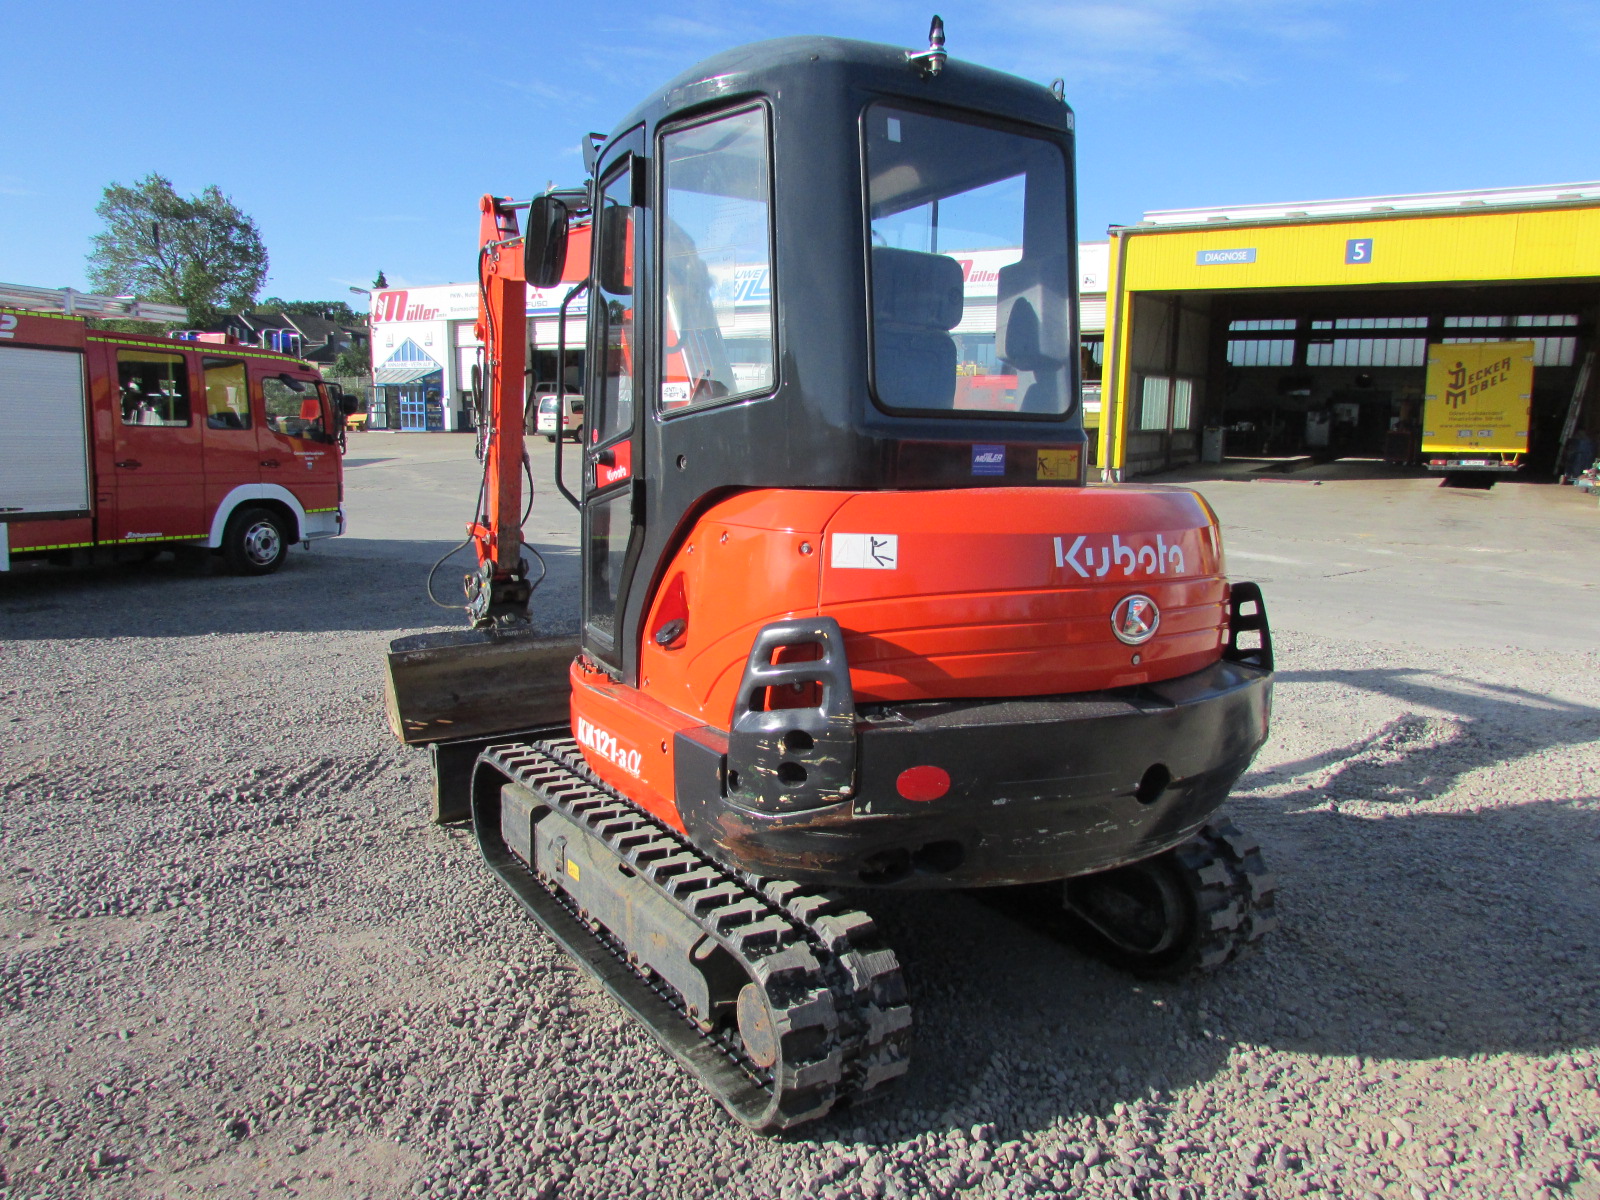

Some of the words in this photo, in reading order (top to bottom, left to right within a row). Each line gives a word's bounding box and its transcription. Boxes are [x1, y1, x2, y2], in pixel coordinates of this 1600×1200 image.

[1204, 251, 1247, 262] DIAGNOSE
[1352, 243, 1366, 260] 5
[374, 290, 440, 322] Müller
[1053, 534, 1185, 578] Kubota
